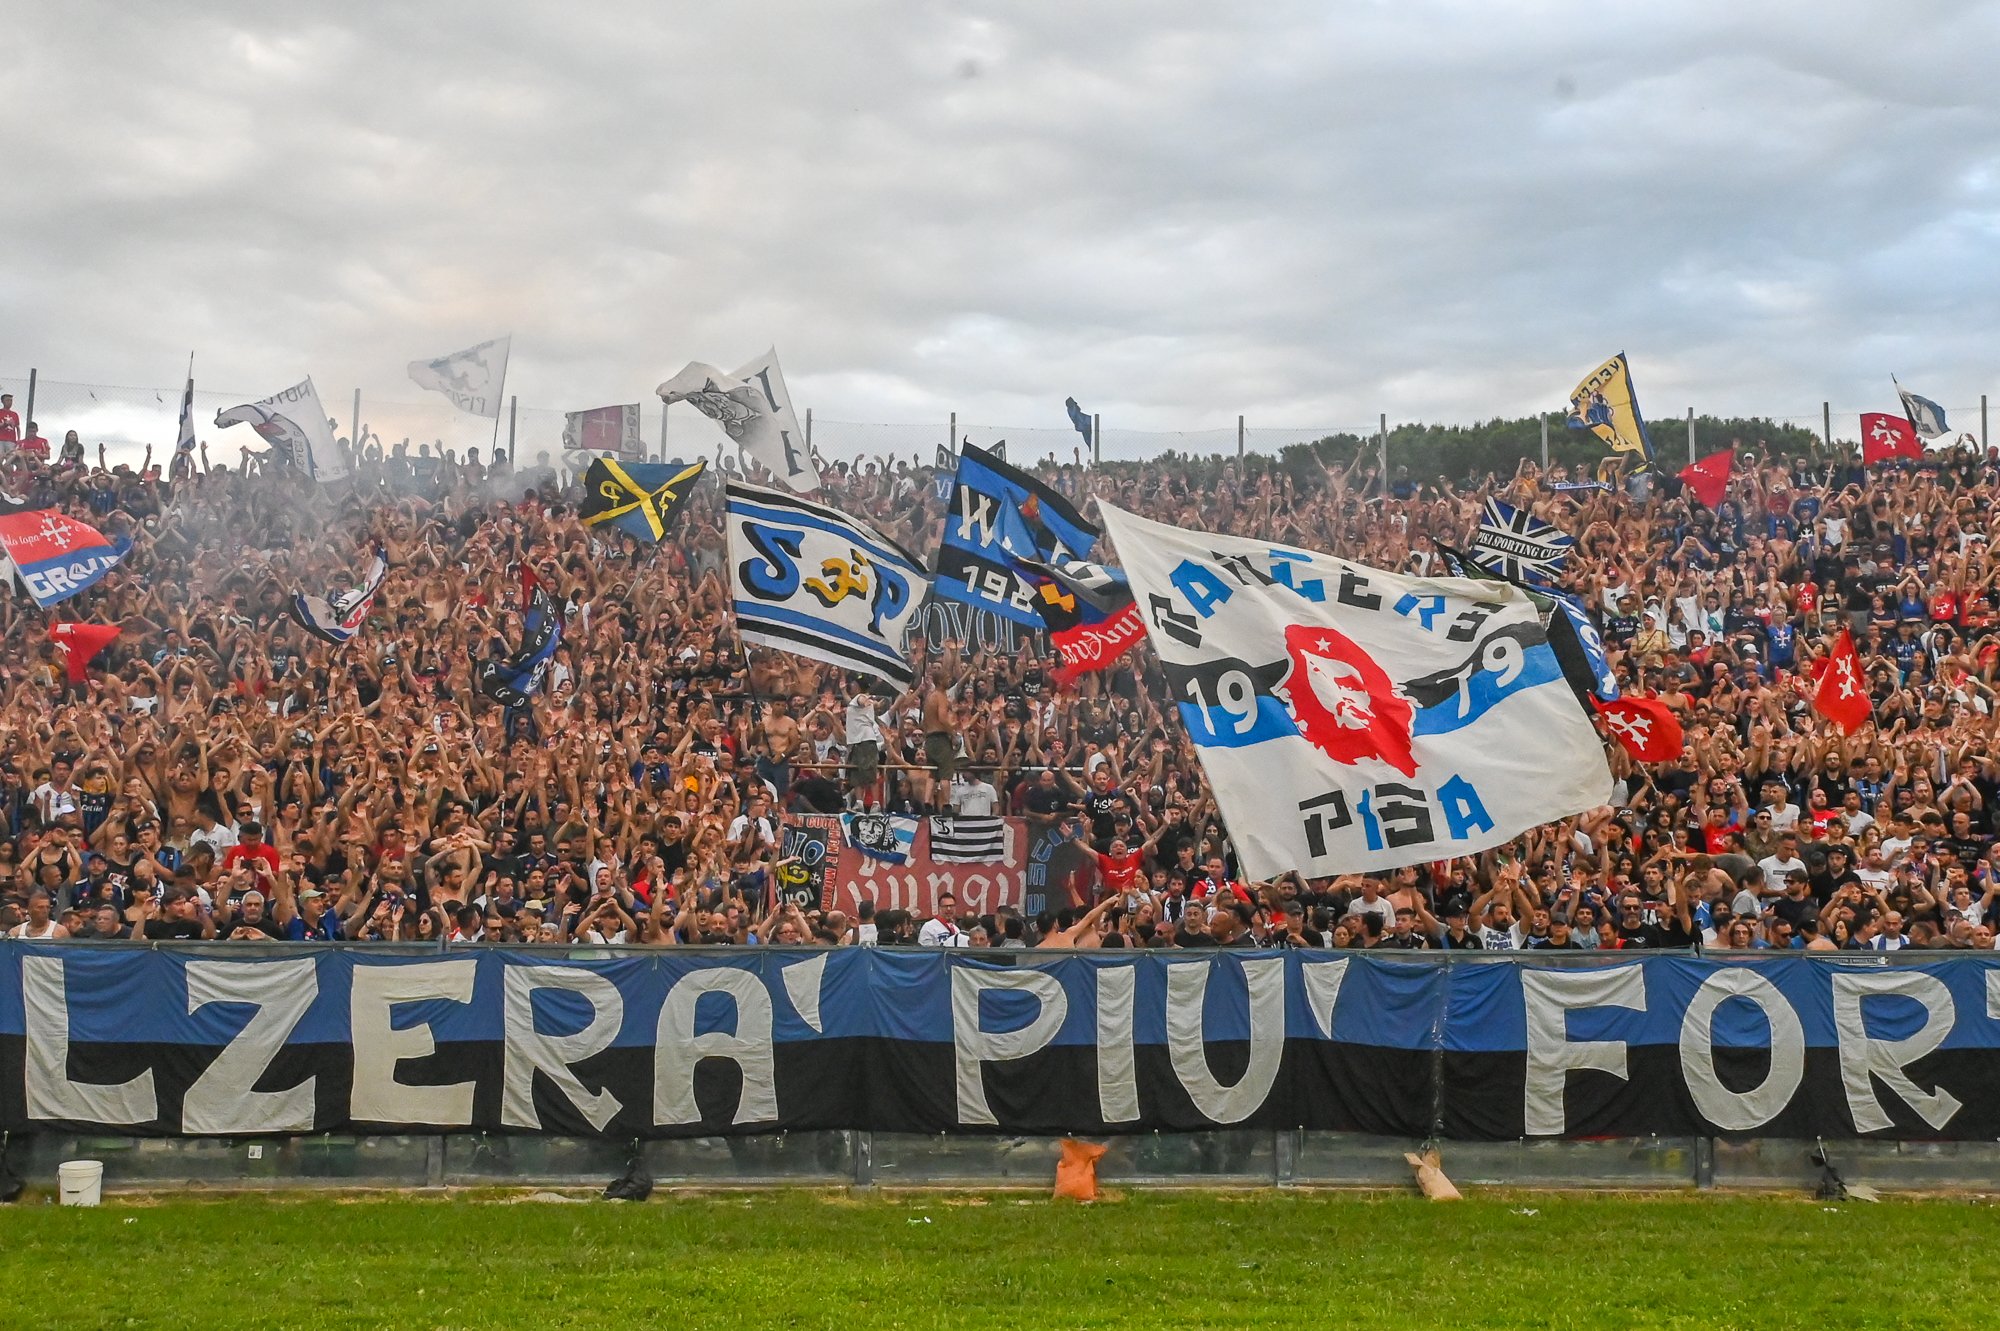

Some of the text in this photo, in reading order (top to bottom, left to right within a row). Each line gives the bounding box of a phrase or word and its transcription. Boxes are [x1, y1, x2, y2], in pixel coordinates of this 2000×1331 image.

[1492, 536, 1540, 558] SPORTING
[1186, 669, 1259, 736] 19
[1298, 773, 1496, 859] PISA
[951, 957, 1349, 1126] PIU'
[1521, 963, 2000, 1135] FOR
